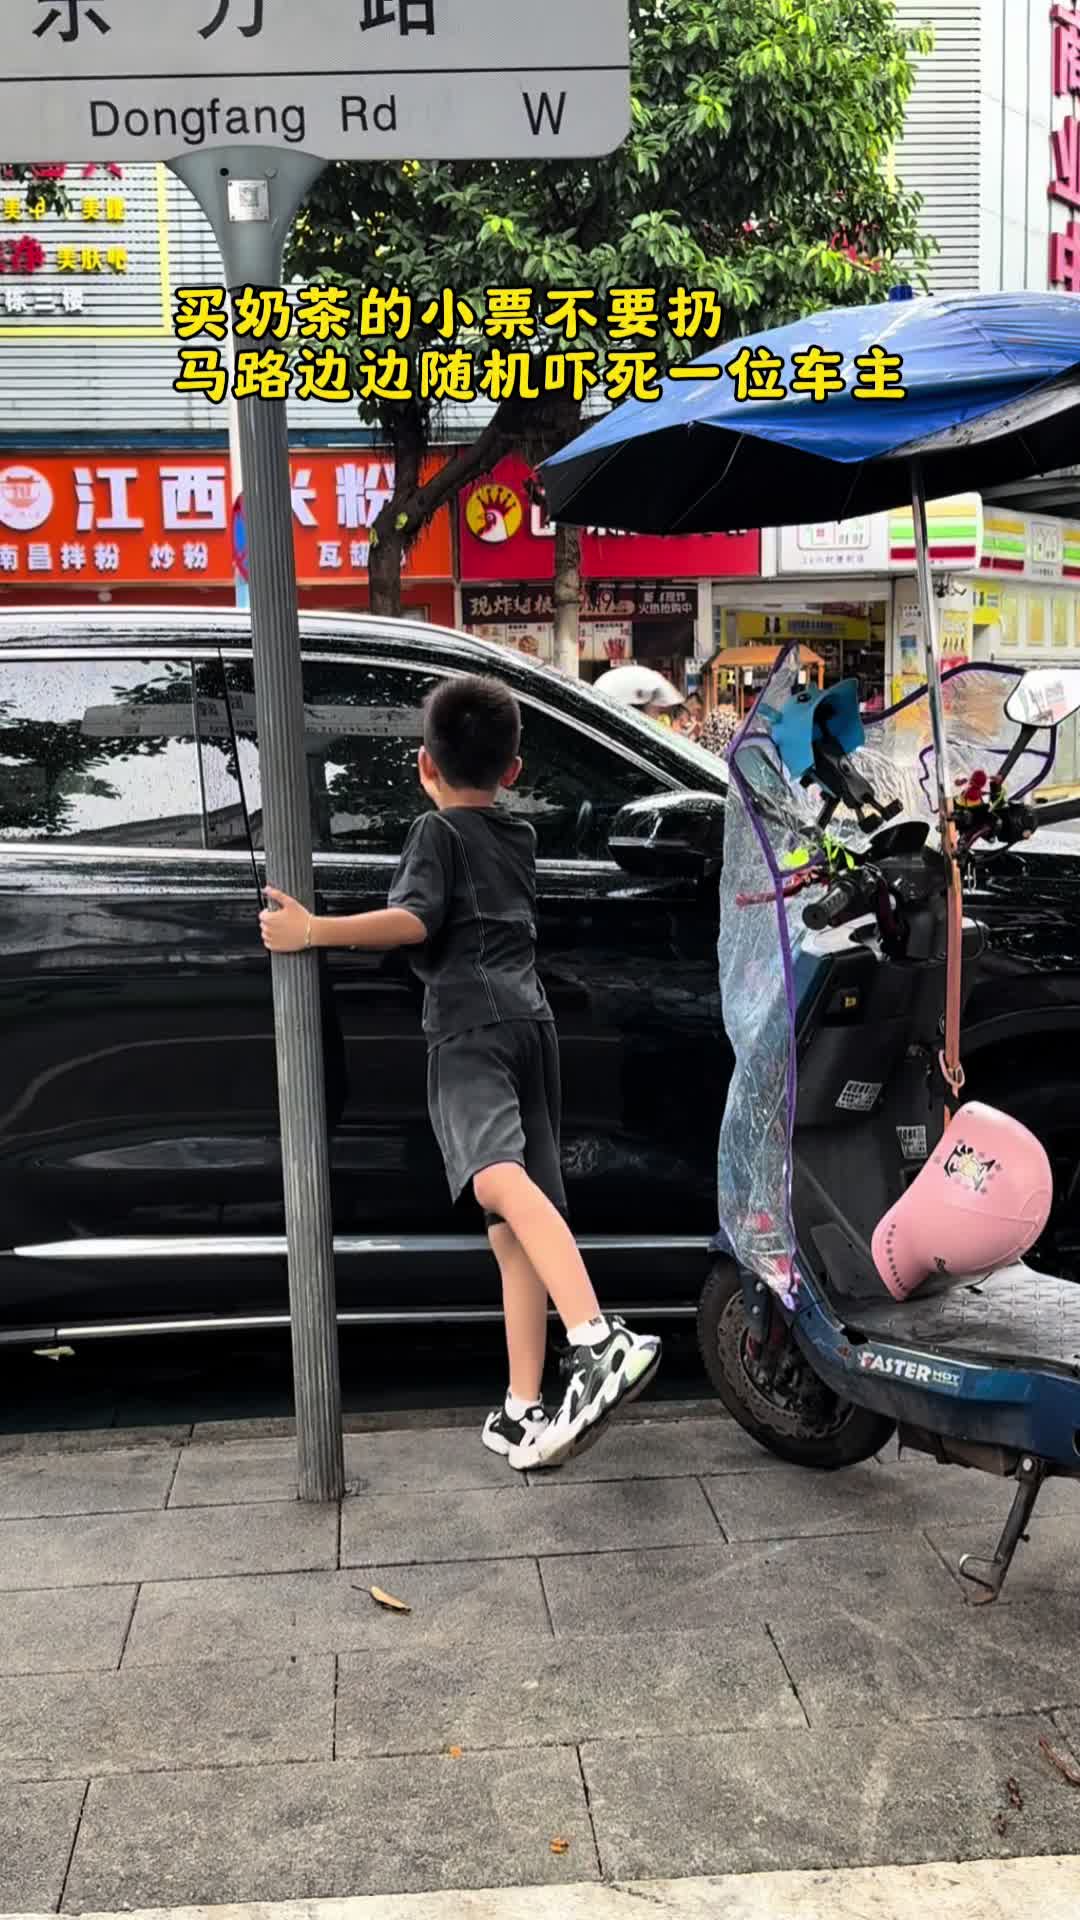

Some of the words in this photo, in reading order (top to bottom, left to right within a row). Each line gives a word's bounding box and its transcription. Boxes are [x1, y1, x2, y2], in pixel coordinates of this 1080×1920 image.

[89, 97, 306, 145] Dongfang
[341, 94, 398, 132] Rd
[522, 91, 567, 136] W
[149, 542, 208, 570] 炒粉
[856, 1351, 931, 1383] FASTER
